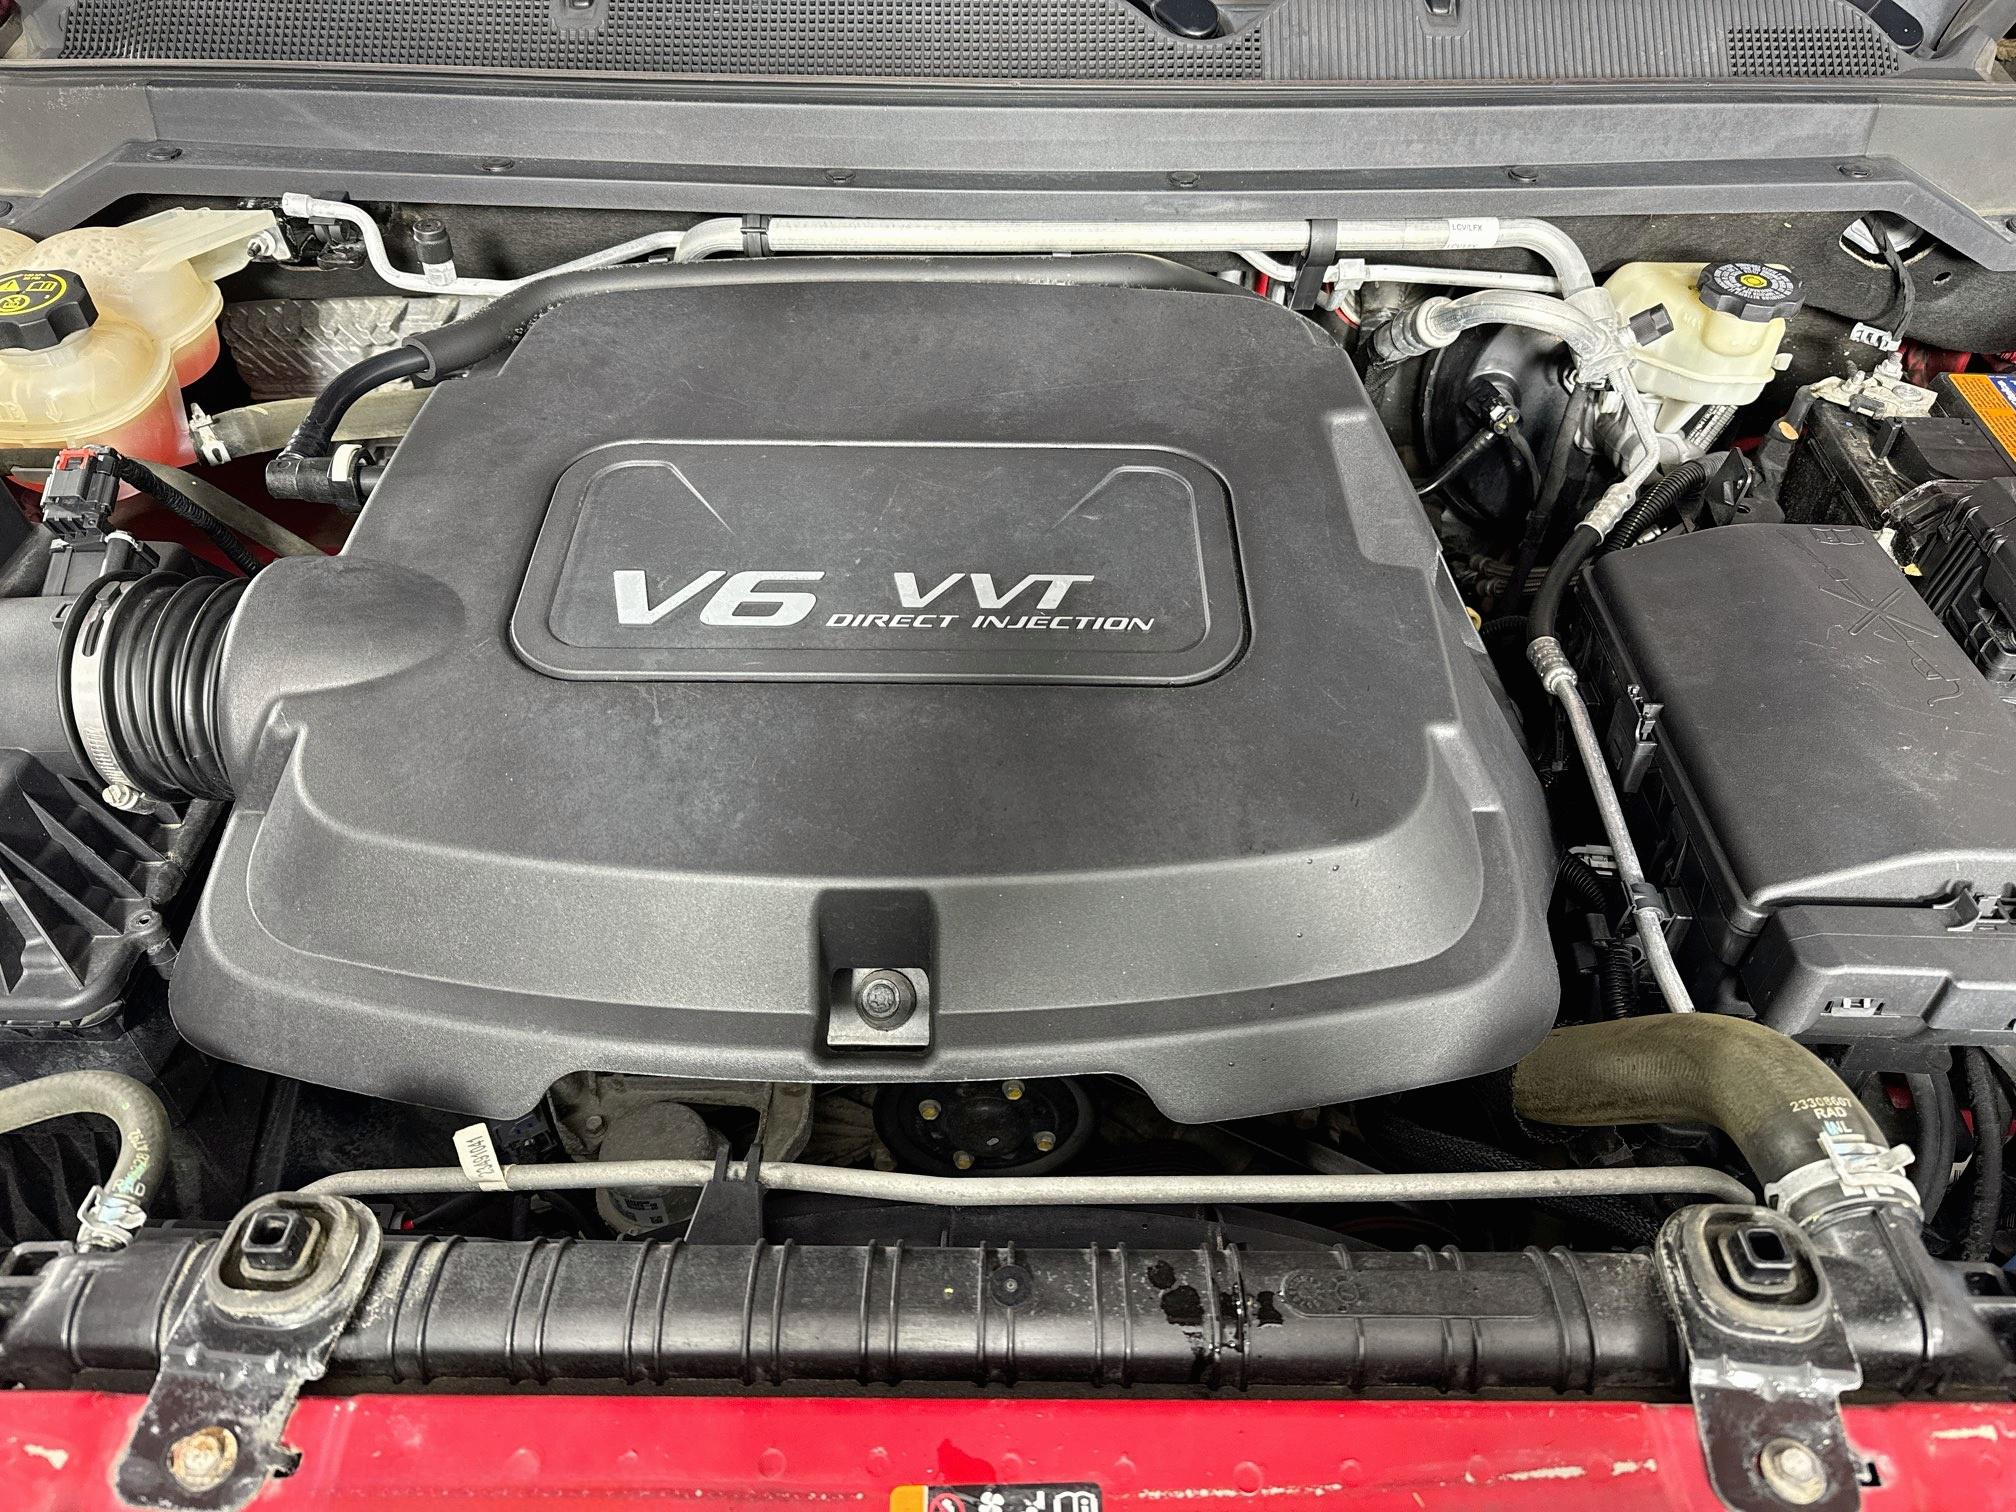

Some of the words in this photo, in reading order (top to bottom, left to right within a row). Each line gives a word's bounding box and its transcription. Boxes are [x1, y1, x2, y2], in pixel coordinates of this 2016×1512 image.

[613, 570, 827, 627] V6
[893, 572, 1096, 610] VVT
[825, 613, 960, 629] DIRECT
[971, 614, 1155, 631] INJECTION
[1813, 1106, 1848, 1120] RAD
